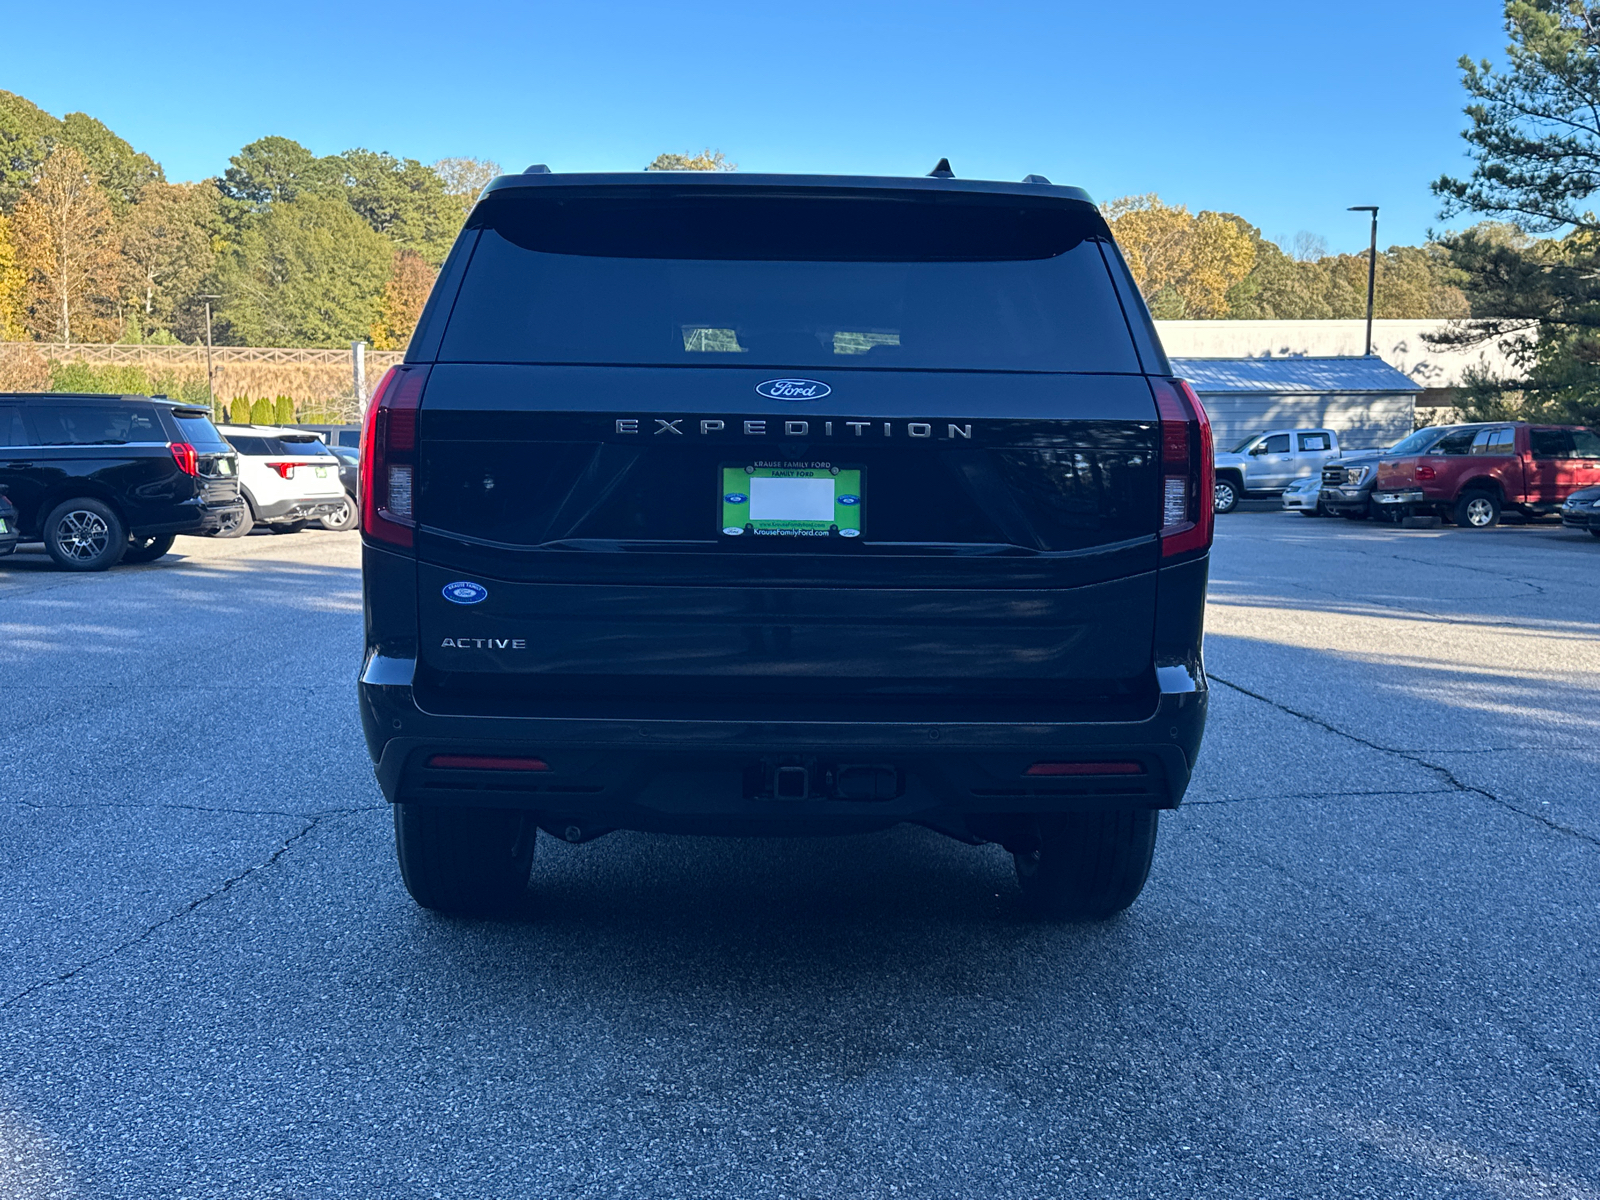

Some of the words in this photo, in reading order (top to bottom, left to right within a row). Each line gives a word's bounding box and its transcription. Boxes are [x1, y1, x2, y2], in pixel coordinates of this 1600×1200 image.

[770, 381, 817, 396] Ford
[616, 419, 972, 439] EXPEDITION
[753, 528, 830, 537] KrauseFamilyFord.com
[441, 638, 526, 649] ACTIVE
